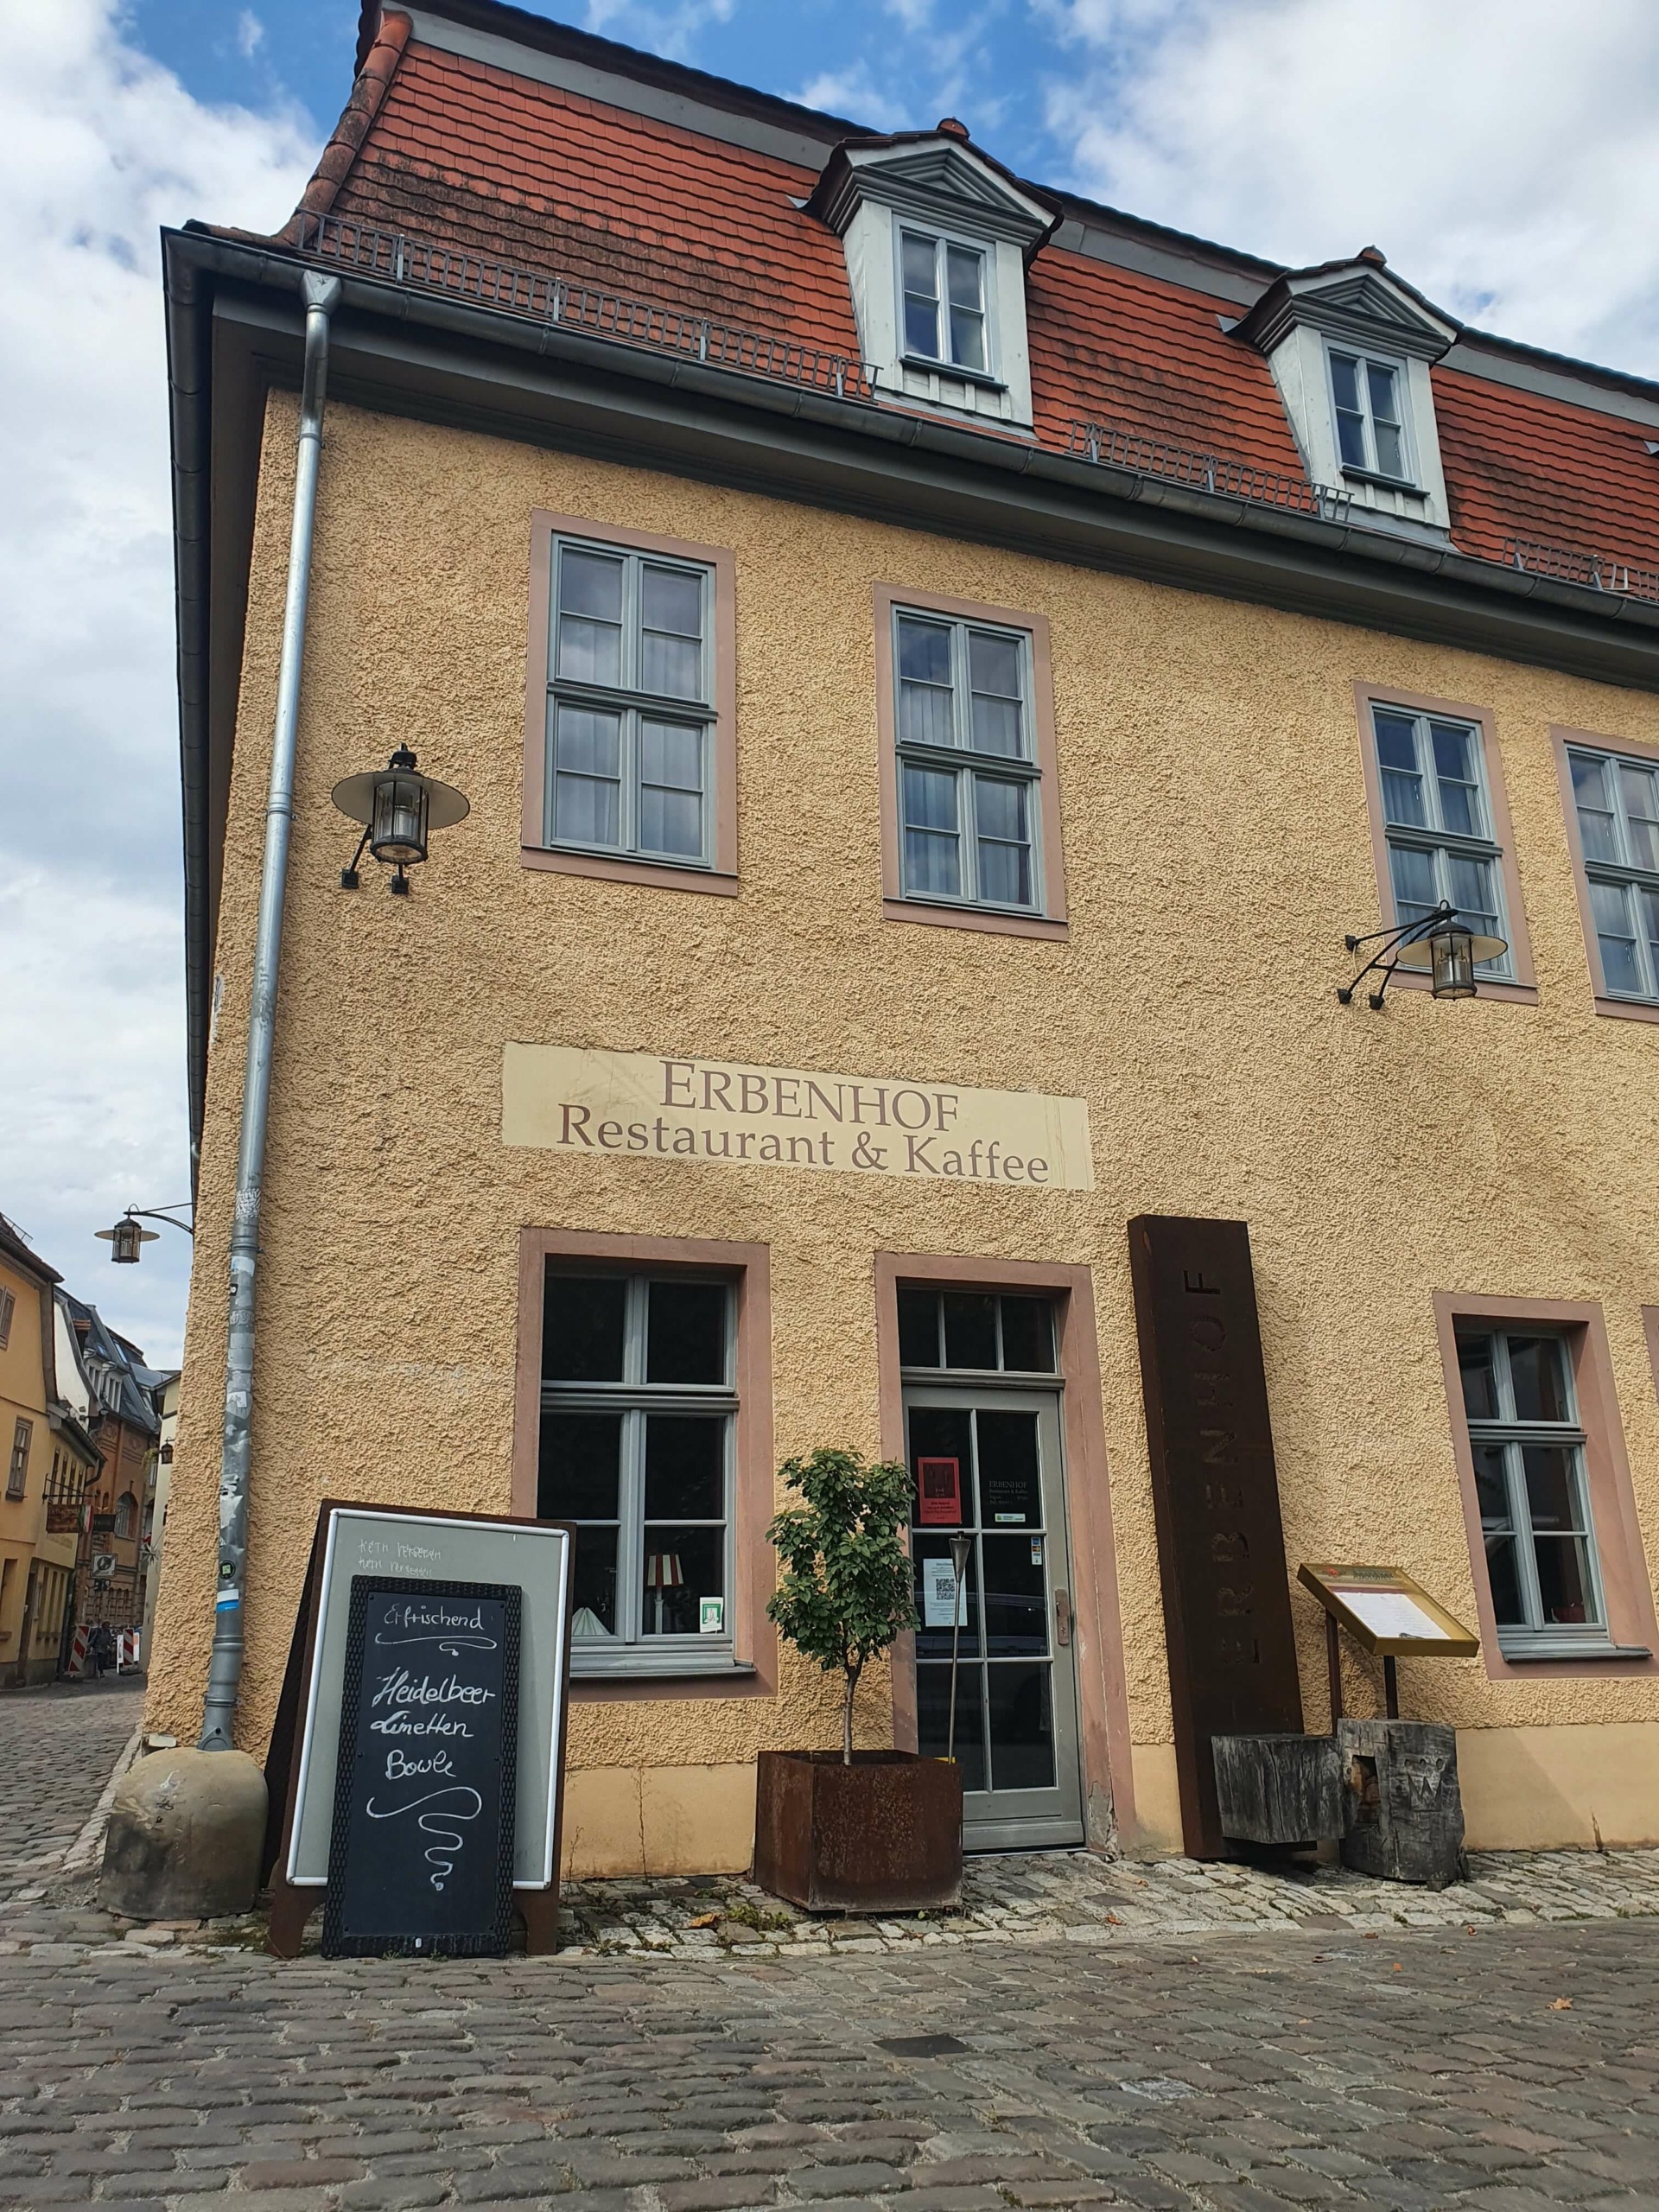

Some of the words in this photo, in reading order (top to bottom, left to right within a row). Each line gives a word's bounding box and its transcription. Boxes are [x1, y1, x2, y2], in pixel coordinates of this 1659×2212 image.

[658, 1059, 959, 1132] ERBENHOF
[556, 1103, 835, 1166] Restaurant
[850, 1131, 889, 1171] &
[904, 1135, 1049, 1184] Kaffee
[384, 1603, 485, 1630] Erfrischend
[372, 1667, 496, 1708] Heidelbeer
[370, 1710, 474, 1738] Limetten
[385, 1749, 456, 1780] Bowle
